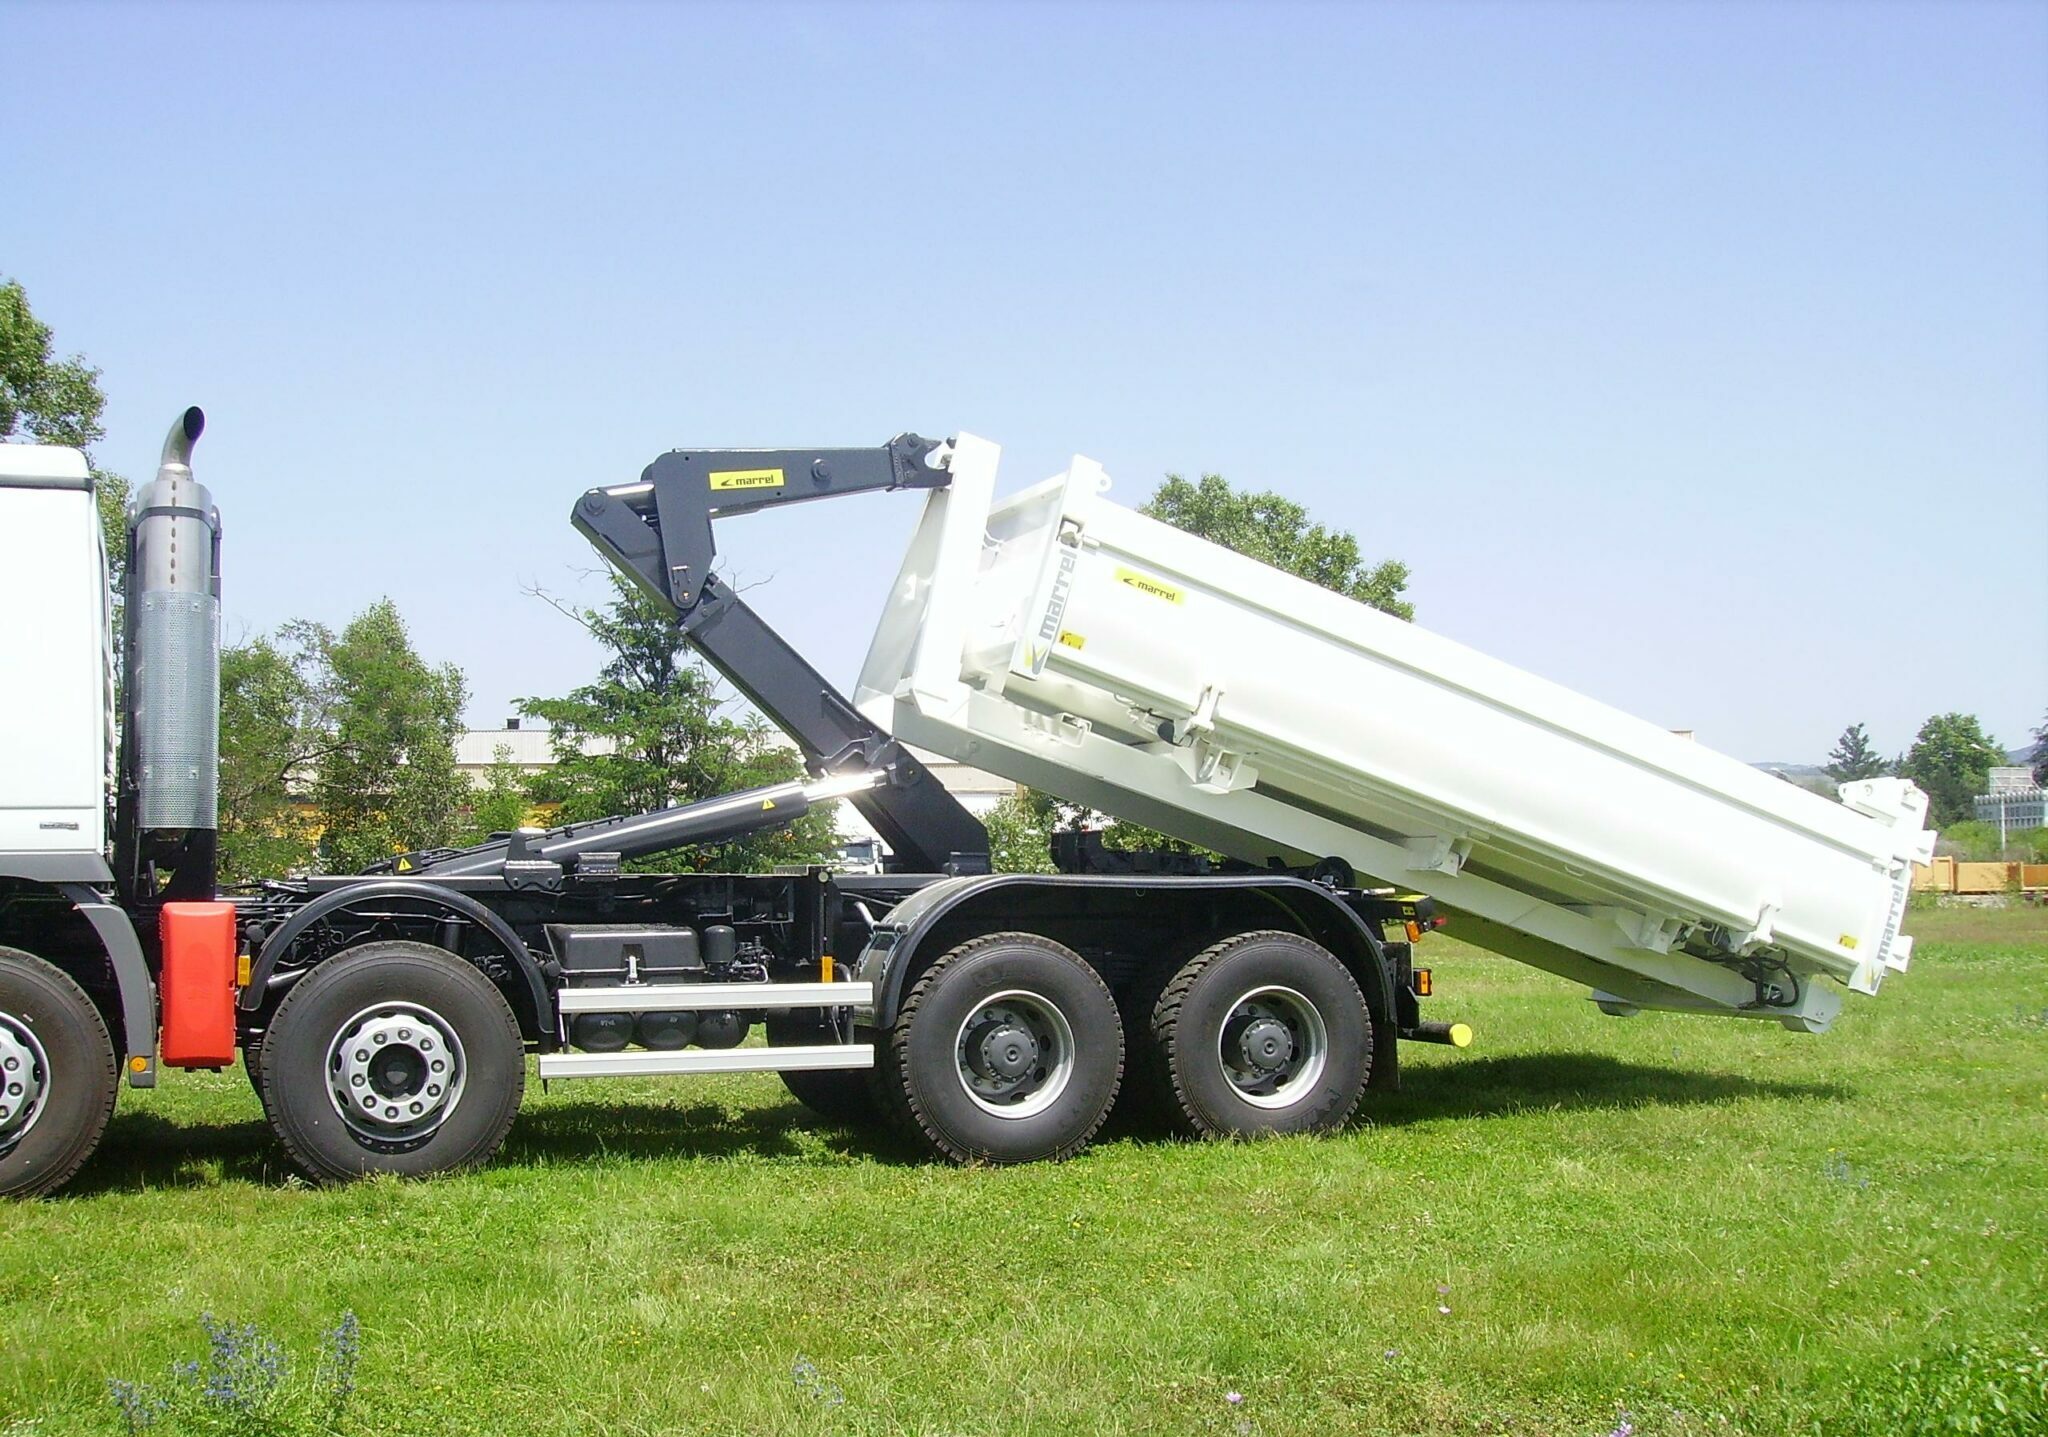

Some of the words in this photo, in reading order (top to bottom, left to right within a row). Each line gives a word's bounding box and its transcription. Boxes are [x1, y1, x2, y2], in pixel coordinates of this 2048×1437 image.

[735, 474, 774, 486] marrel
[1038, 549, 1077, 641] marrel
[1137, 580, 1176, 601] marrel
[1877, 883, 1904, 962] marrel
